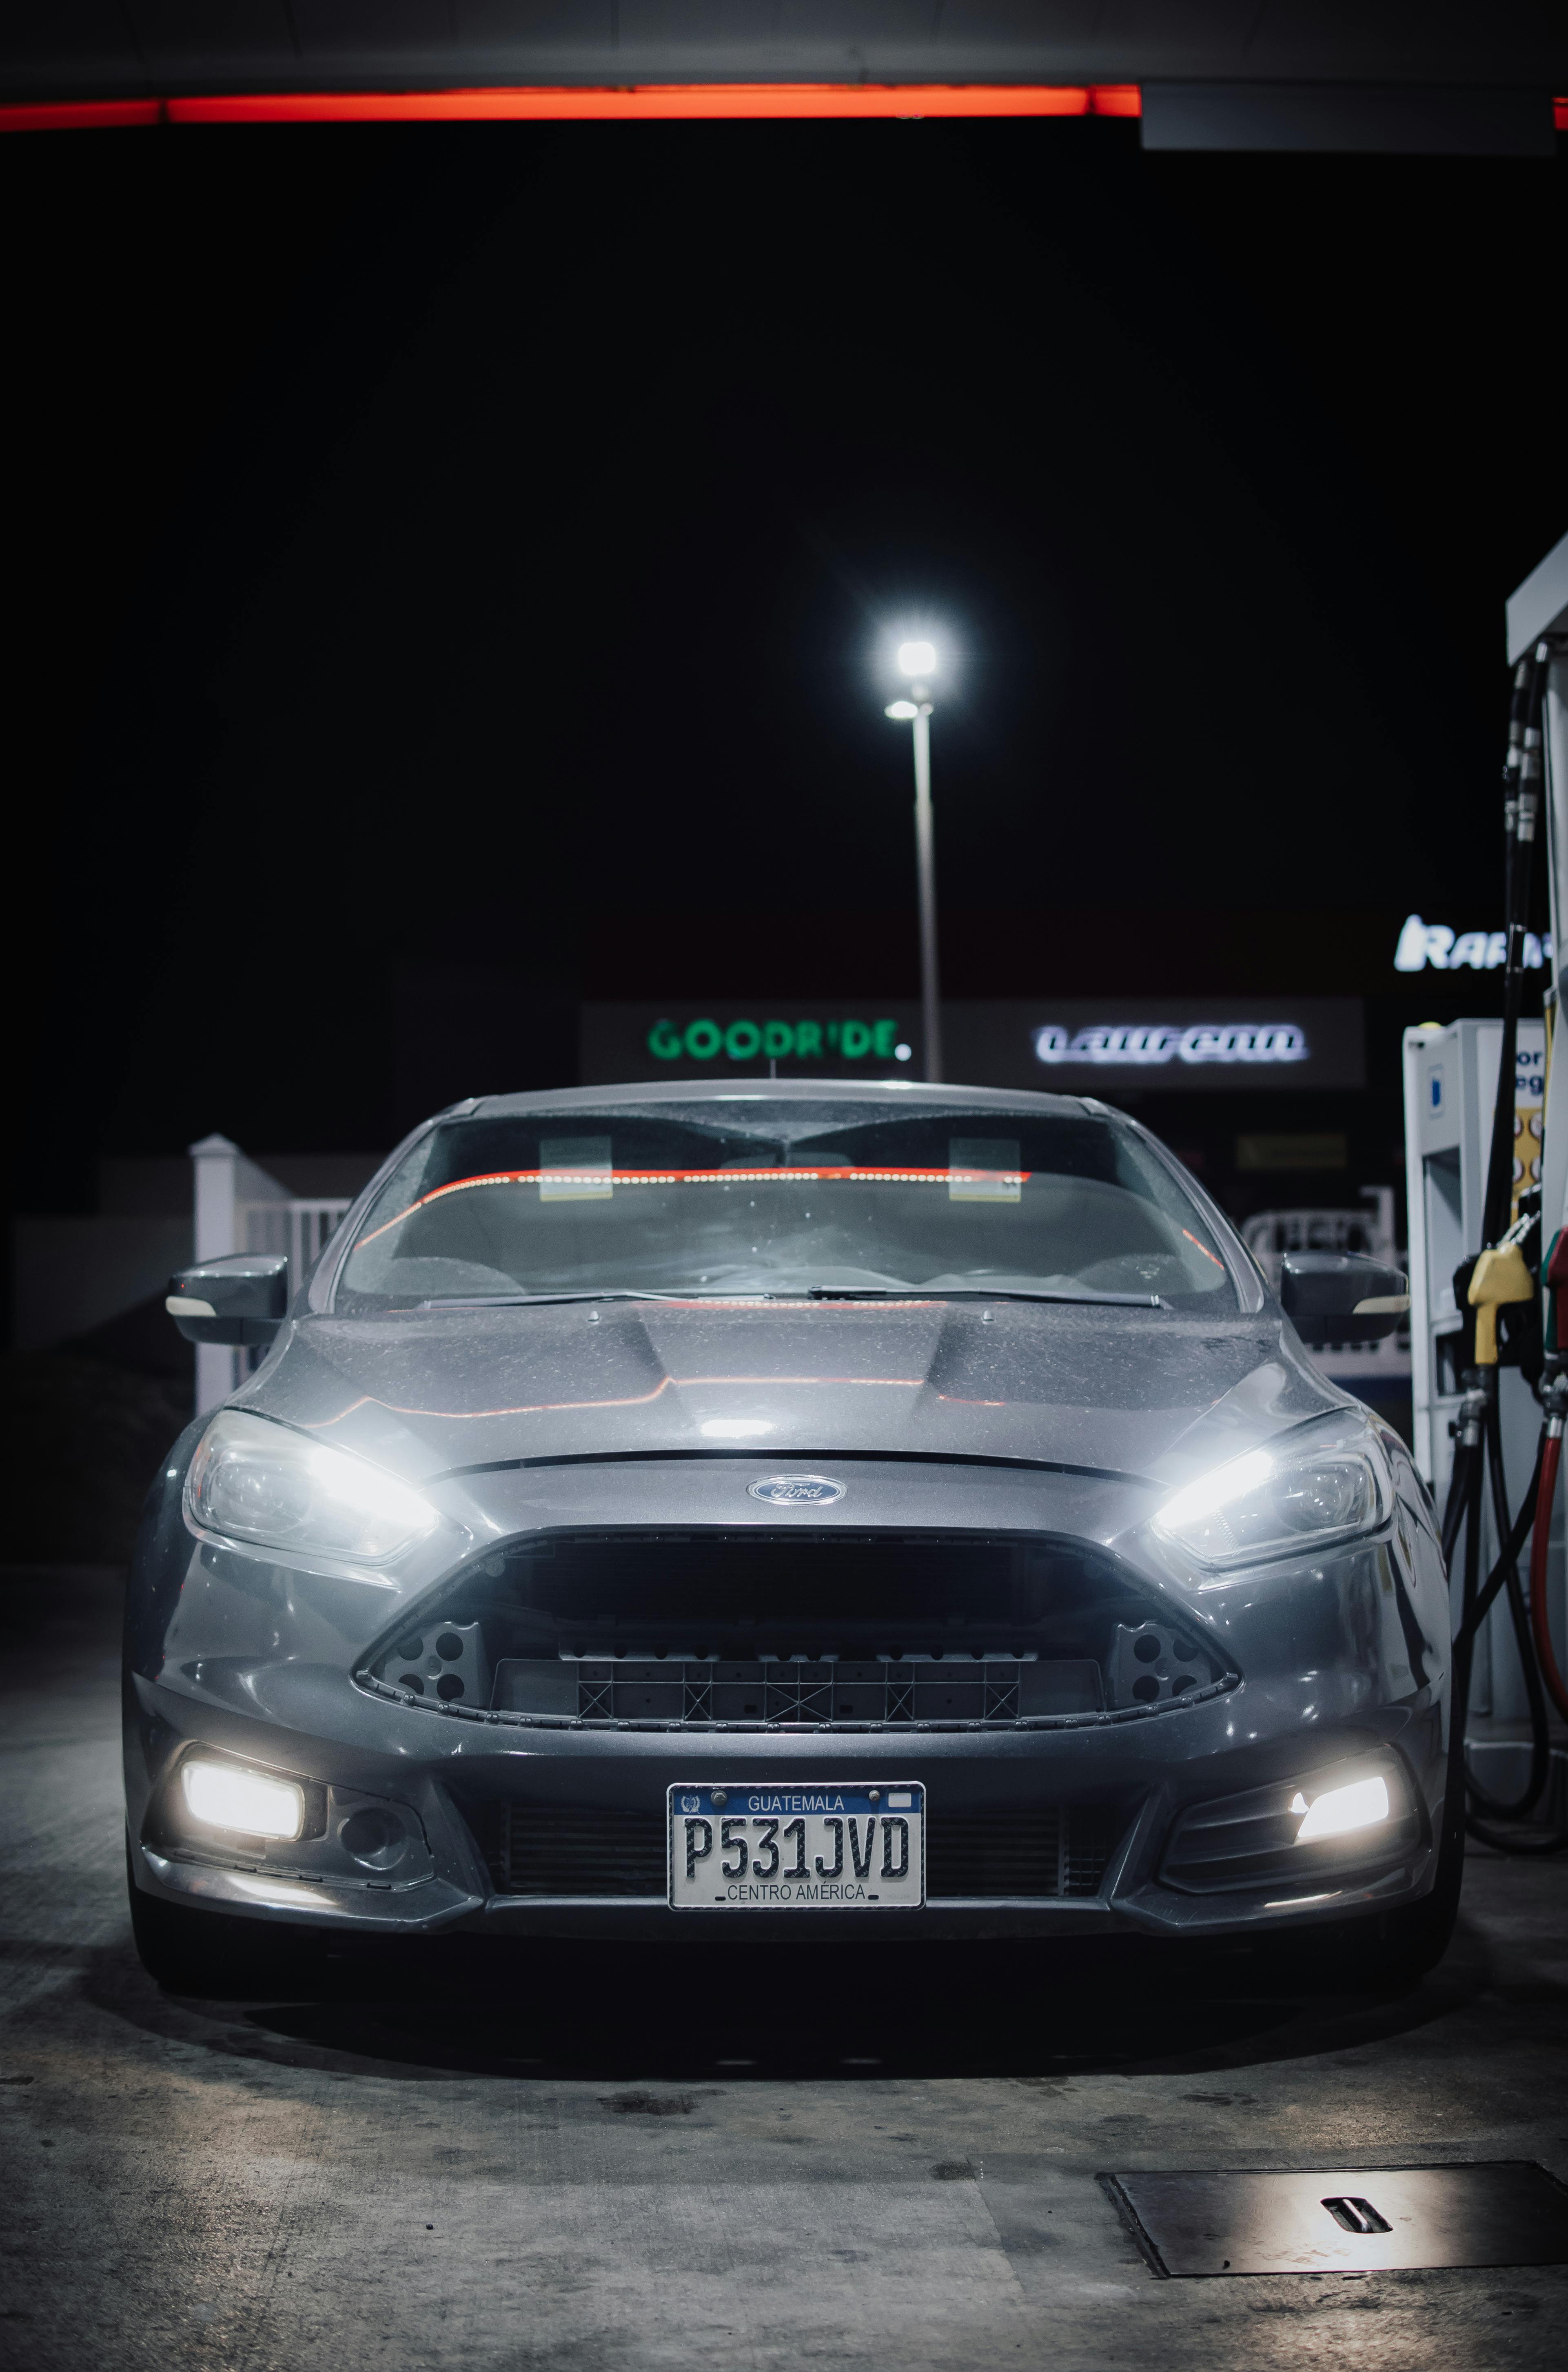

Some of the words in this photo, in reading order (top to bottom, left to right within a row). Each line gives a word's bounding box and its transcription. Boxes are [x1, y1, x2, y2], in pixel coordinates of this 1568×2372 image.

[771, 1482, 823, 1497] Ford
[748, 1795, 845, 1811] GUATEMALA
[684, 1817, 909, 1878] P531JVD
[727, 1884, 792, 1900] CENTRO
[796, 1881, 865, 1900] AMÉRICA
